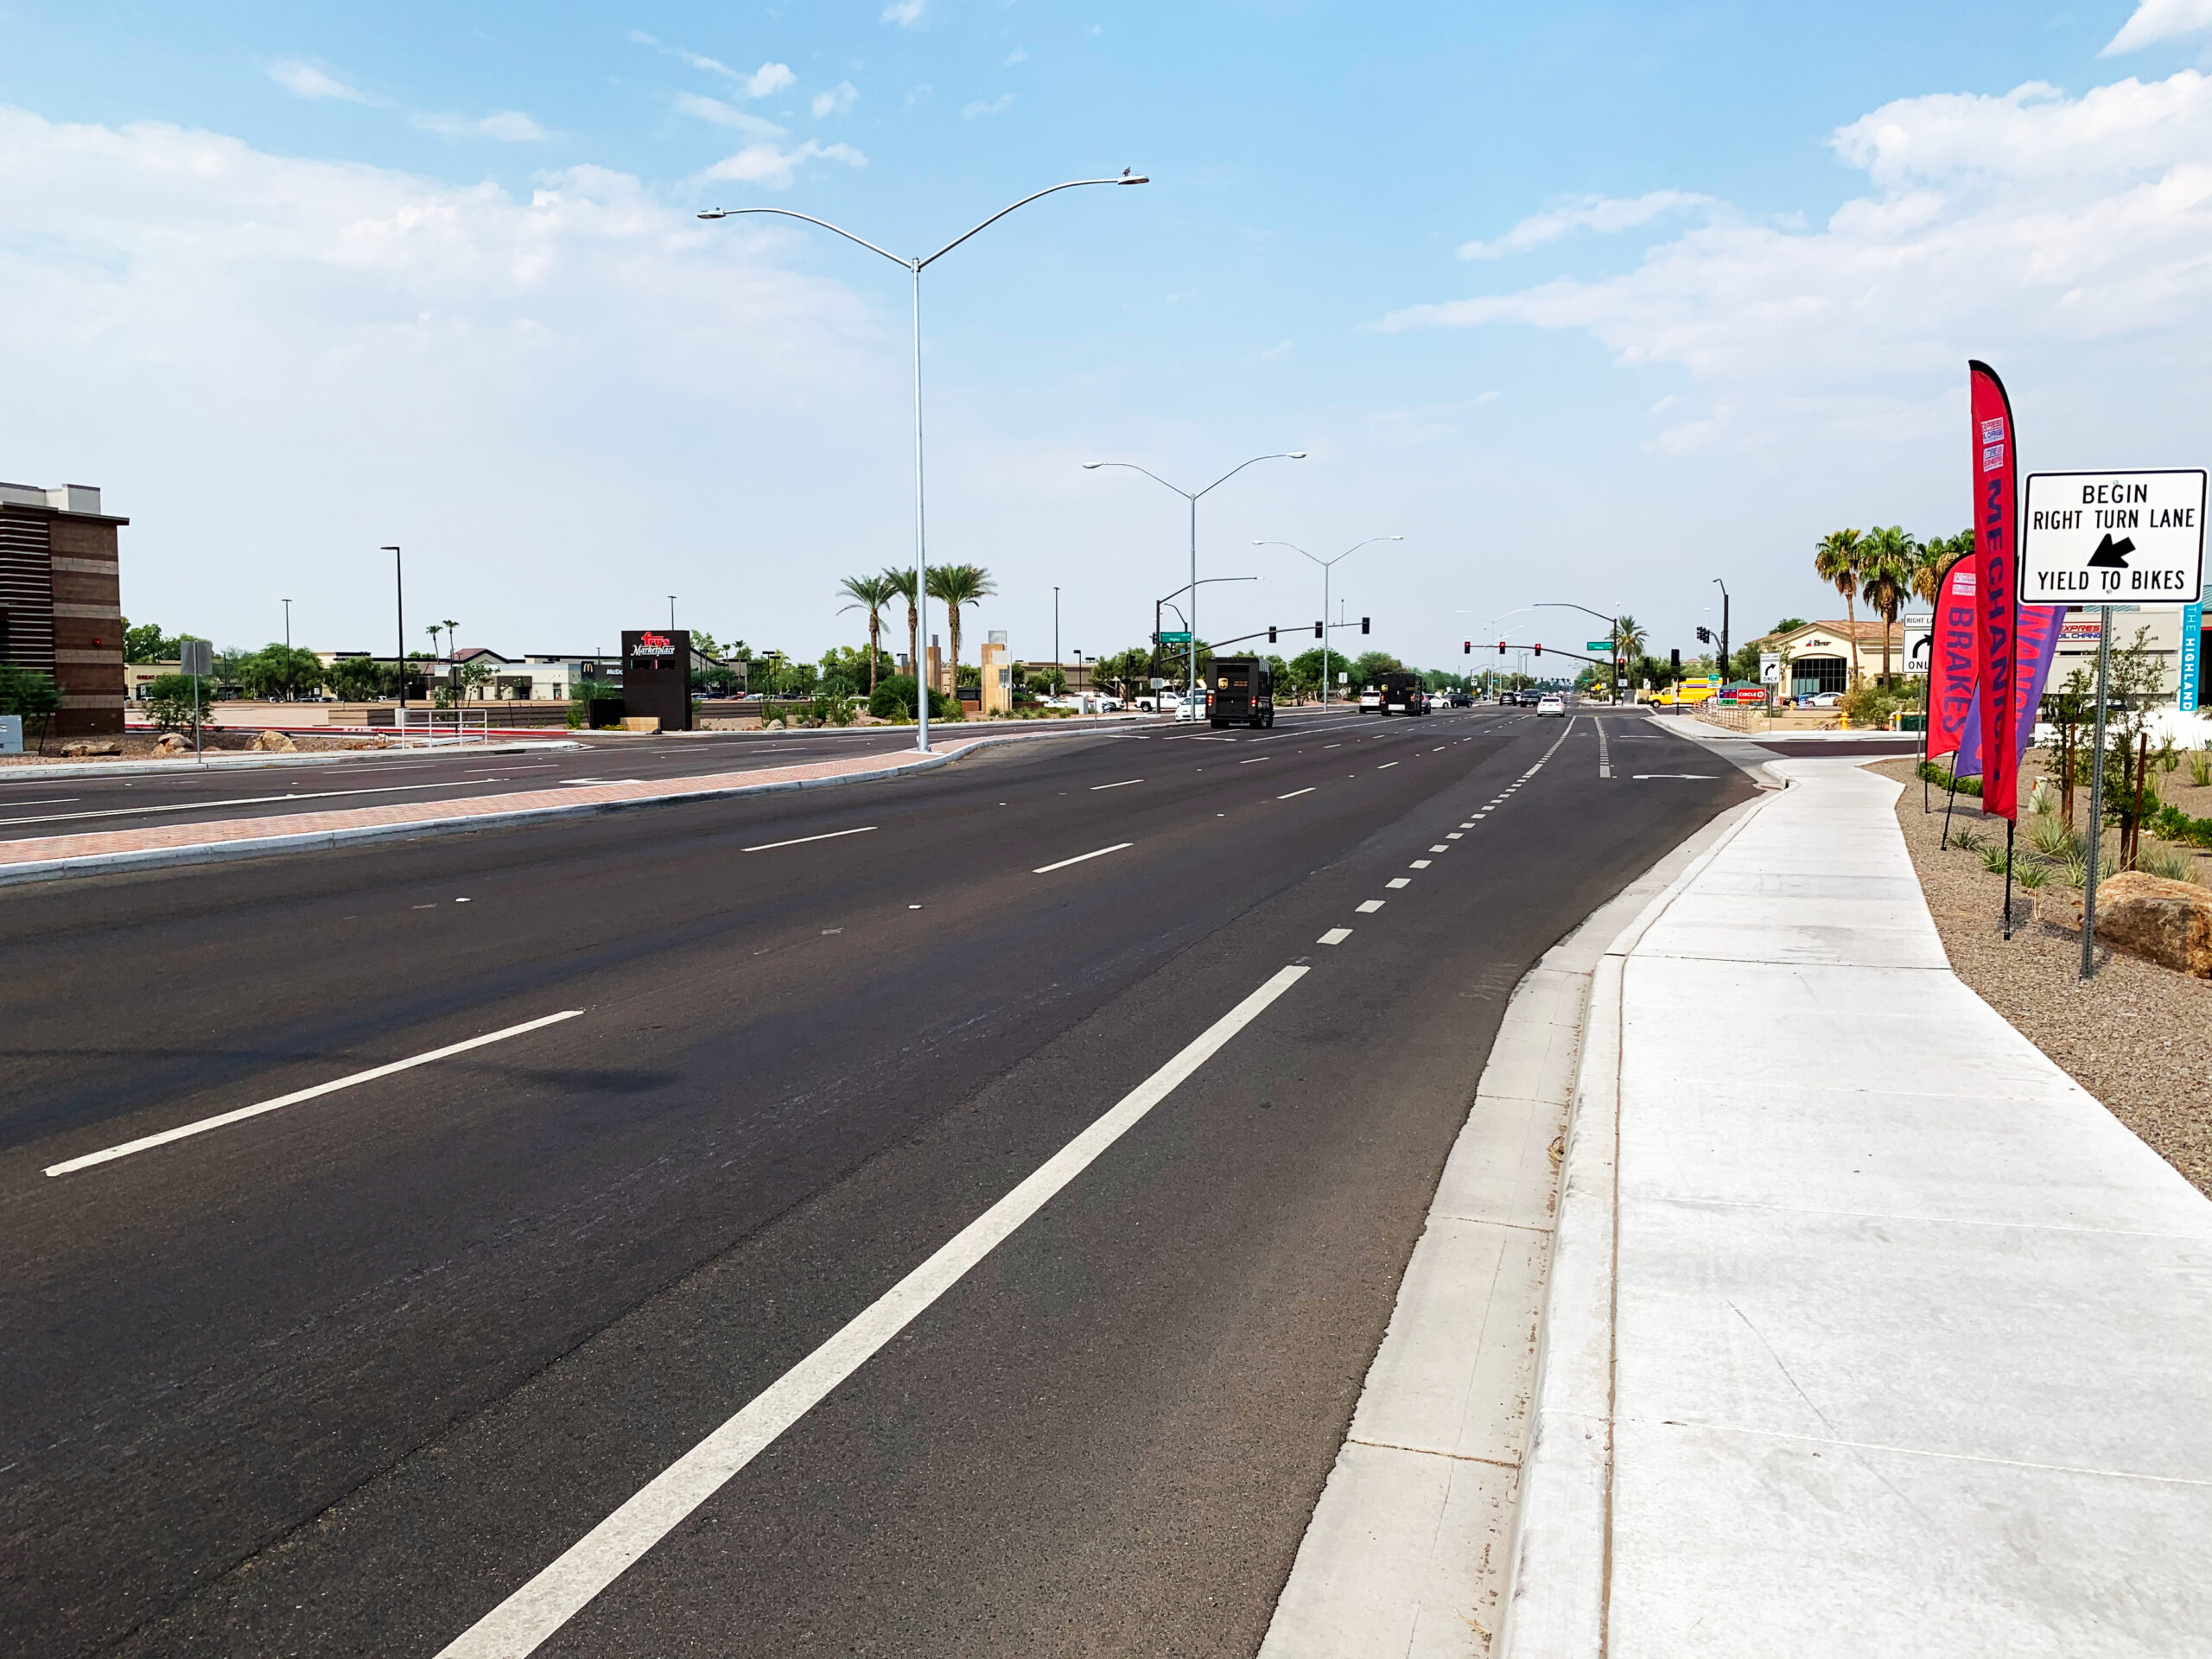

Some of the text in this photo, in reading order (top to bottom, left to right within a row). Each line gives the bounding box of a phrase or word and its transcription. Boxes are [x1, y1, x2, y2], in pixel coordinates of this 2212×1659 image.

[2082, 484, 2147, 504] BEGIN
[2033, 508, 2195, 530] RIGHT TURN LANE
[2037, 570, 2184, 590] YIELD TO BIKES
[631, 644, 675, 657] Marketplace
[2183, 607, 2197, 710] THE HIGHLAND
[1908, 661, 1929, 670] ONL
[1942, 607, 1974, 734] BRAKES
